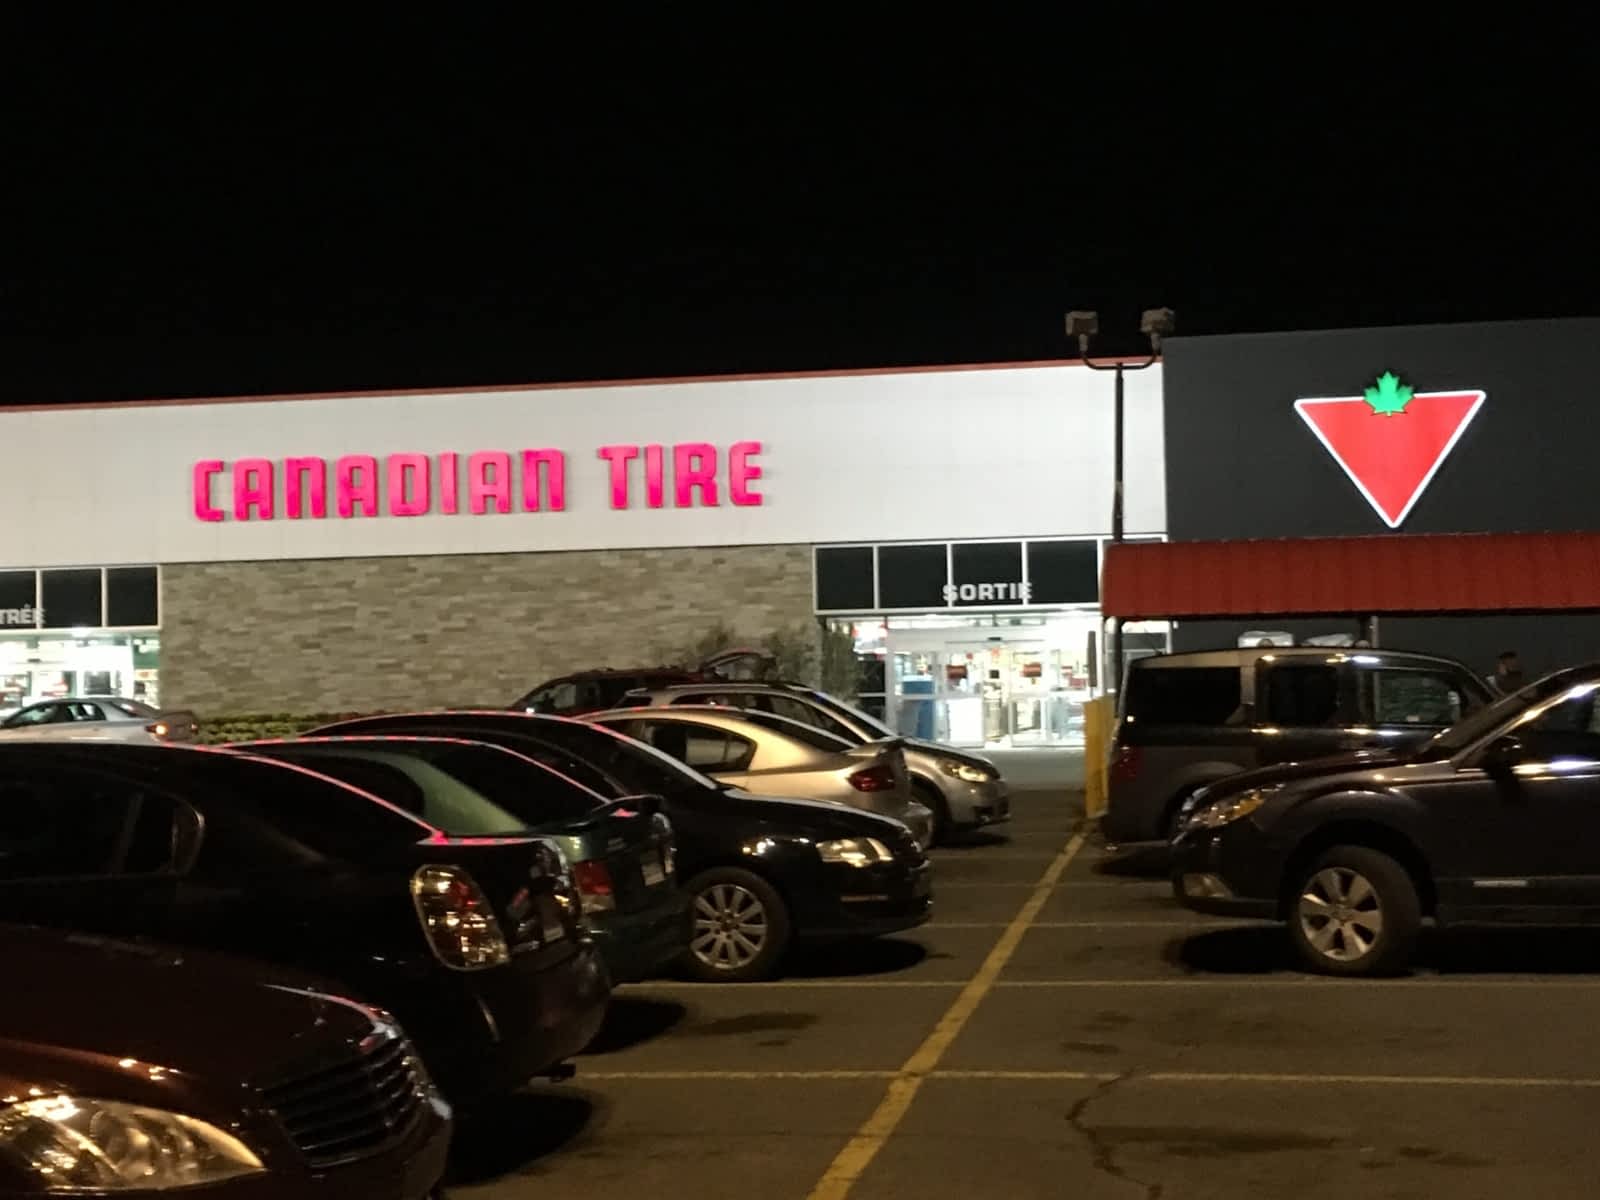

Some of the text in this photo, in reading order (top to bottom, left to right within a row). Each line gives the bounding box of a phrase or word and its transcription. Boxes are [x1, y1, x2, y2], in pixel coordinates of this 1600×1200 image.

[193, 440, 764, 522] CANADIAN TIRE
[943, 582, 1032, 601] SORTIE
